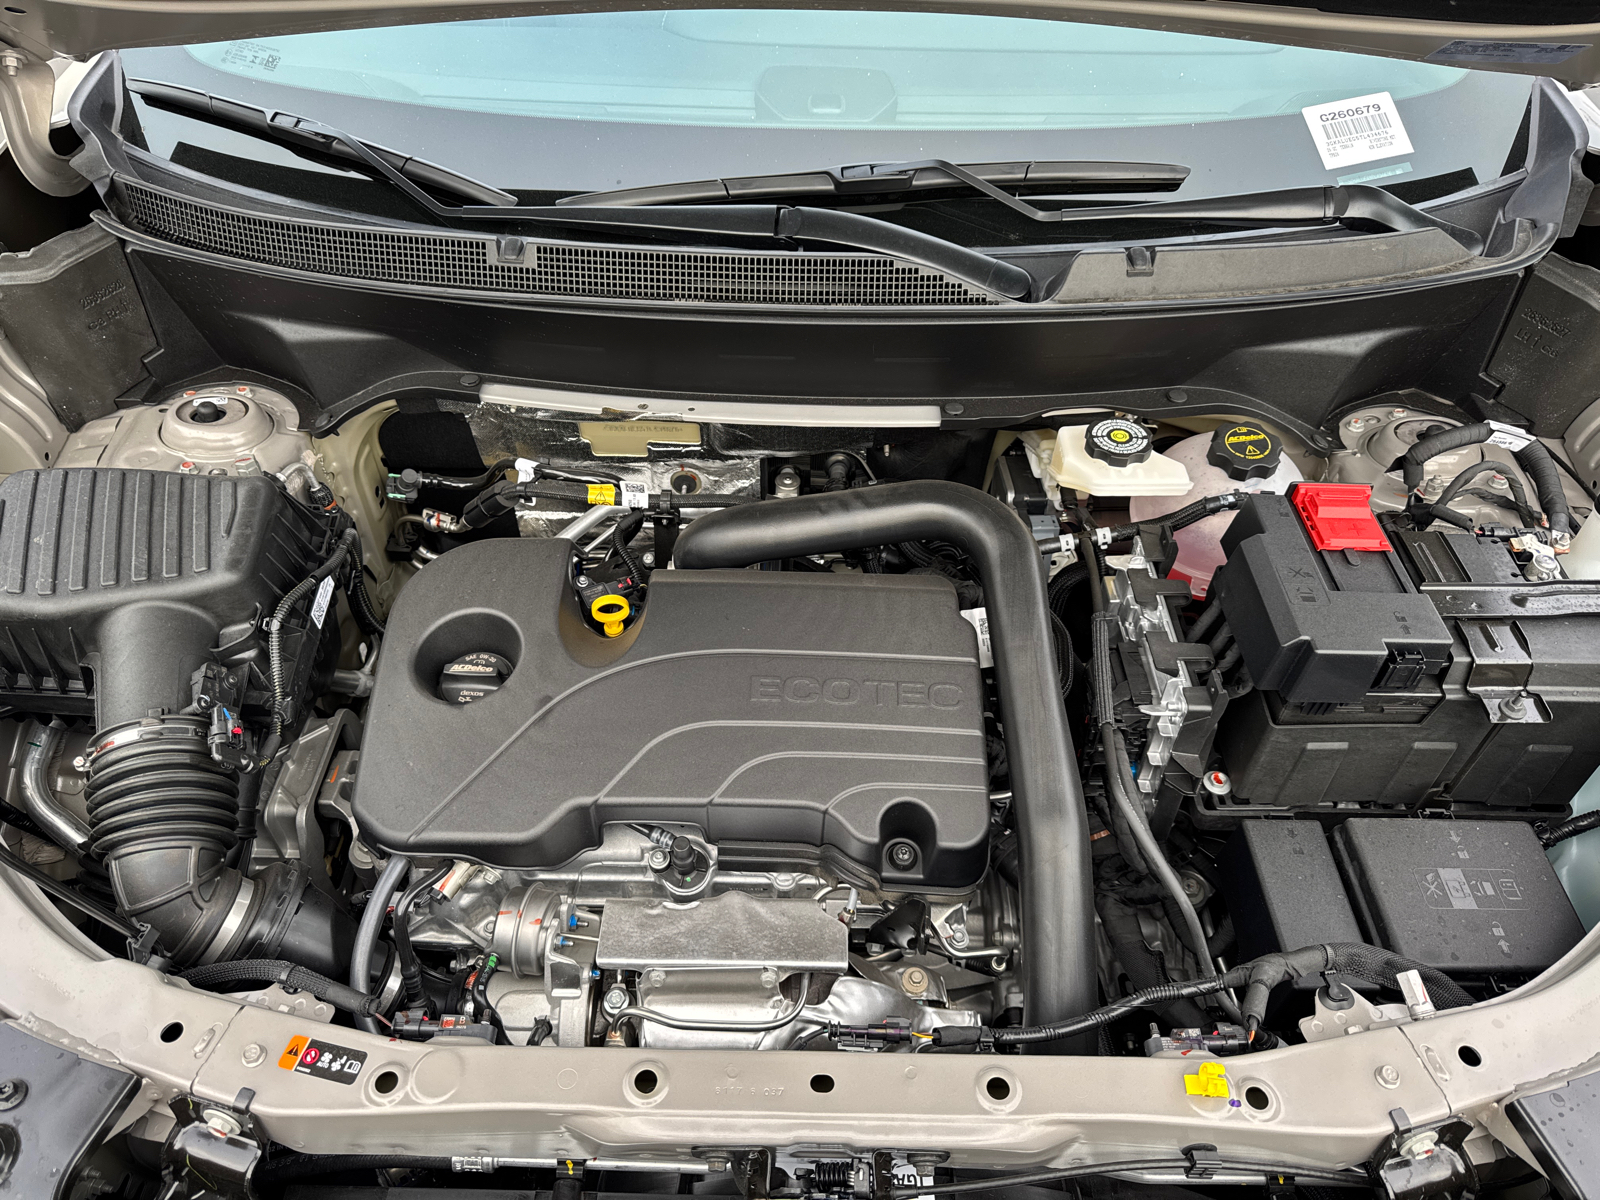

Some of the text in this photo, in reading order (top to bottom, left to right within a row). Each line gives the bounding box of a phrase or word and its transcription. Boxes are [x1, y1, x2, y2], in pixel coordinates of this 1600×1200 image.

[1319, 103, 1382, 123] G260679
[1227, 434, 1265, 443] ACDelco
[465, 653, 477, 661] SAE
[449, 664, 494, 672] ACDelco
[750, 674, 964, 711] ECOTEC
[316, 1060, 330, 1068] AUTO
